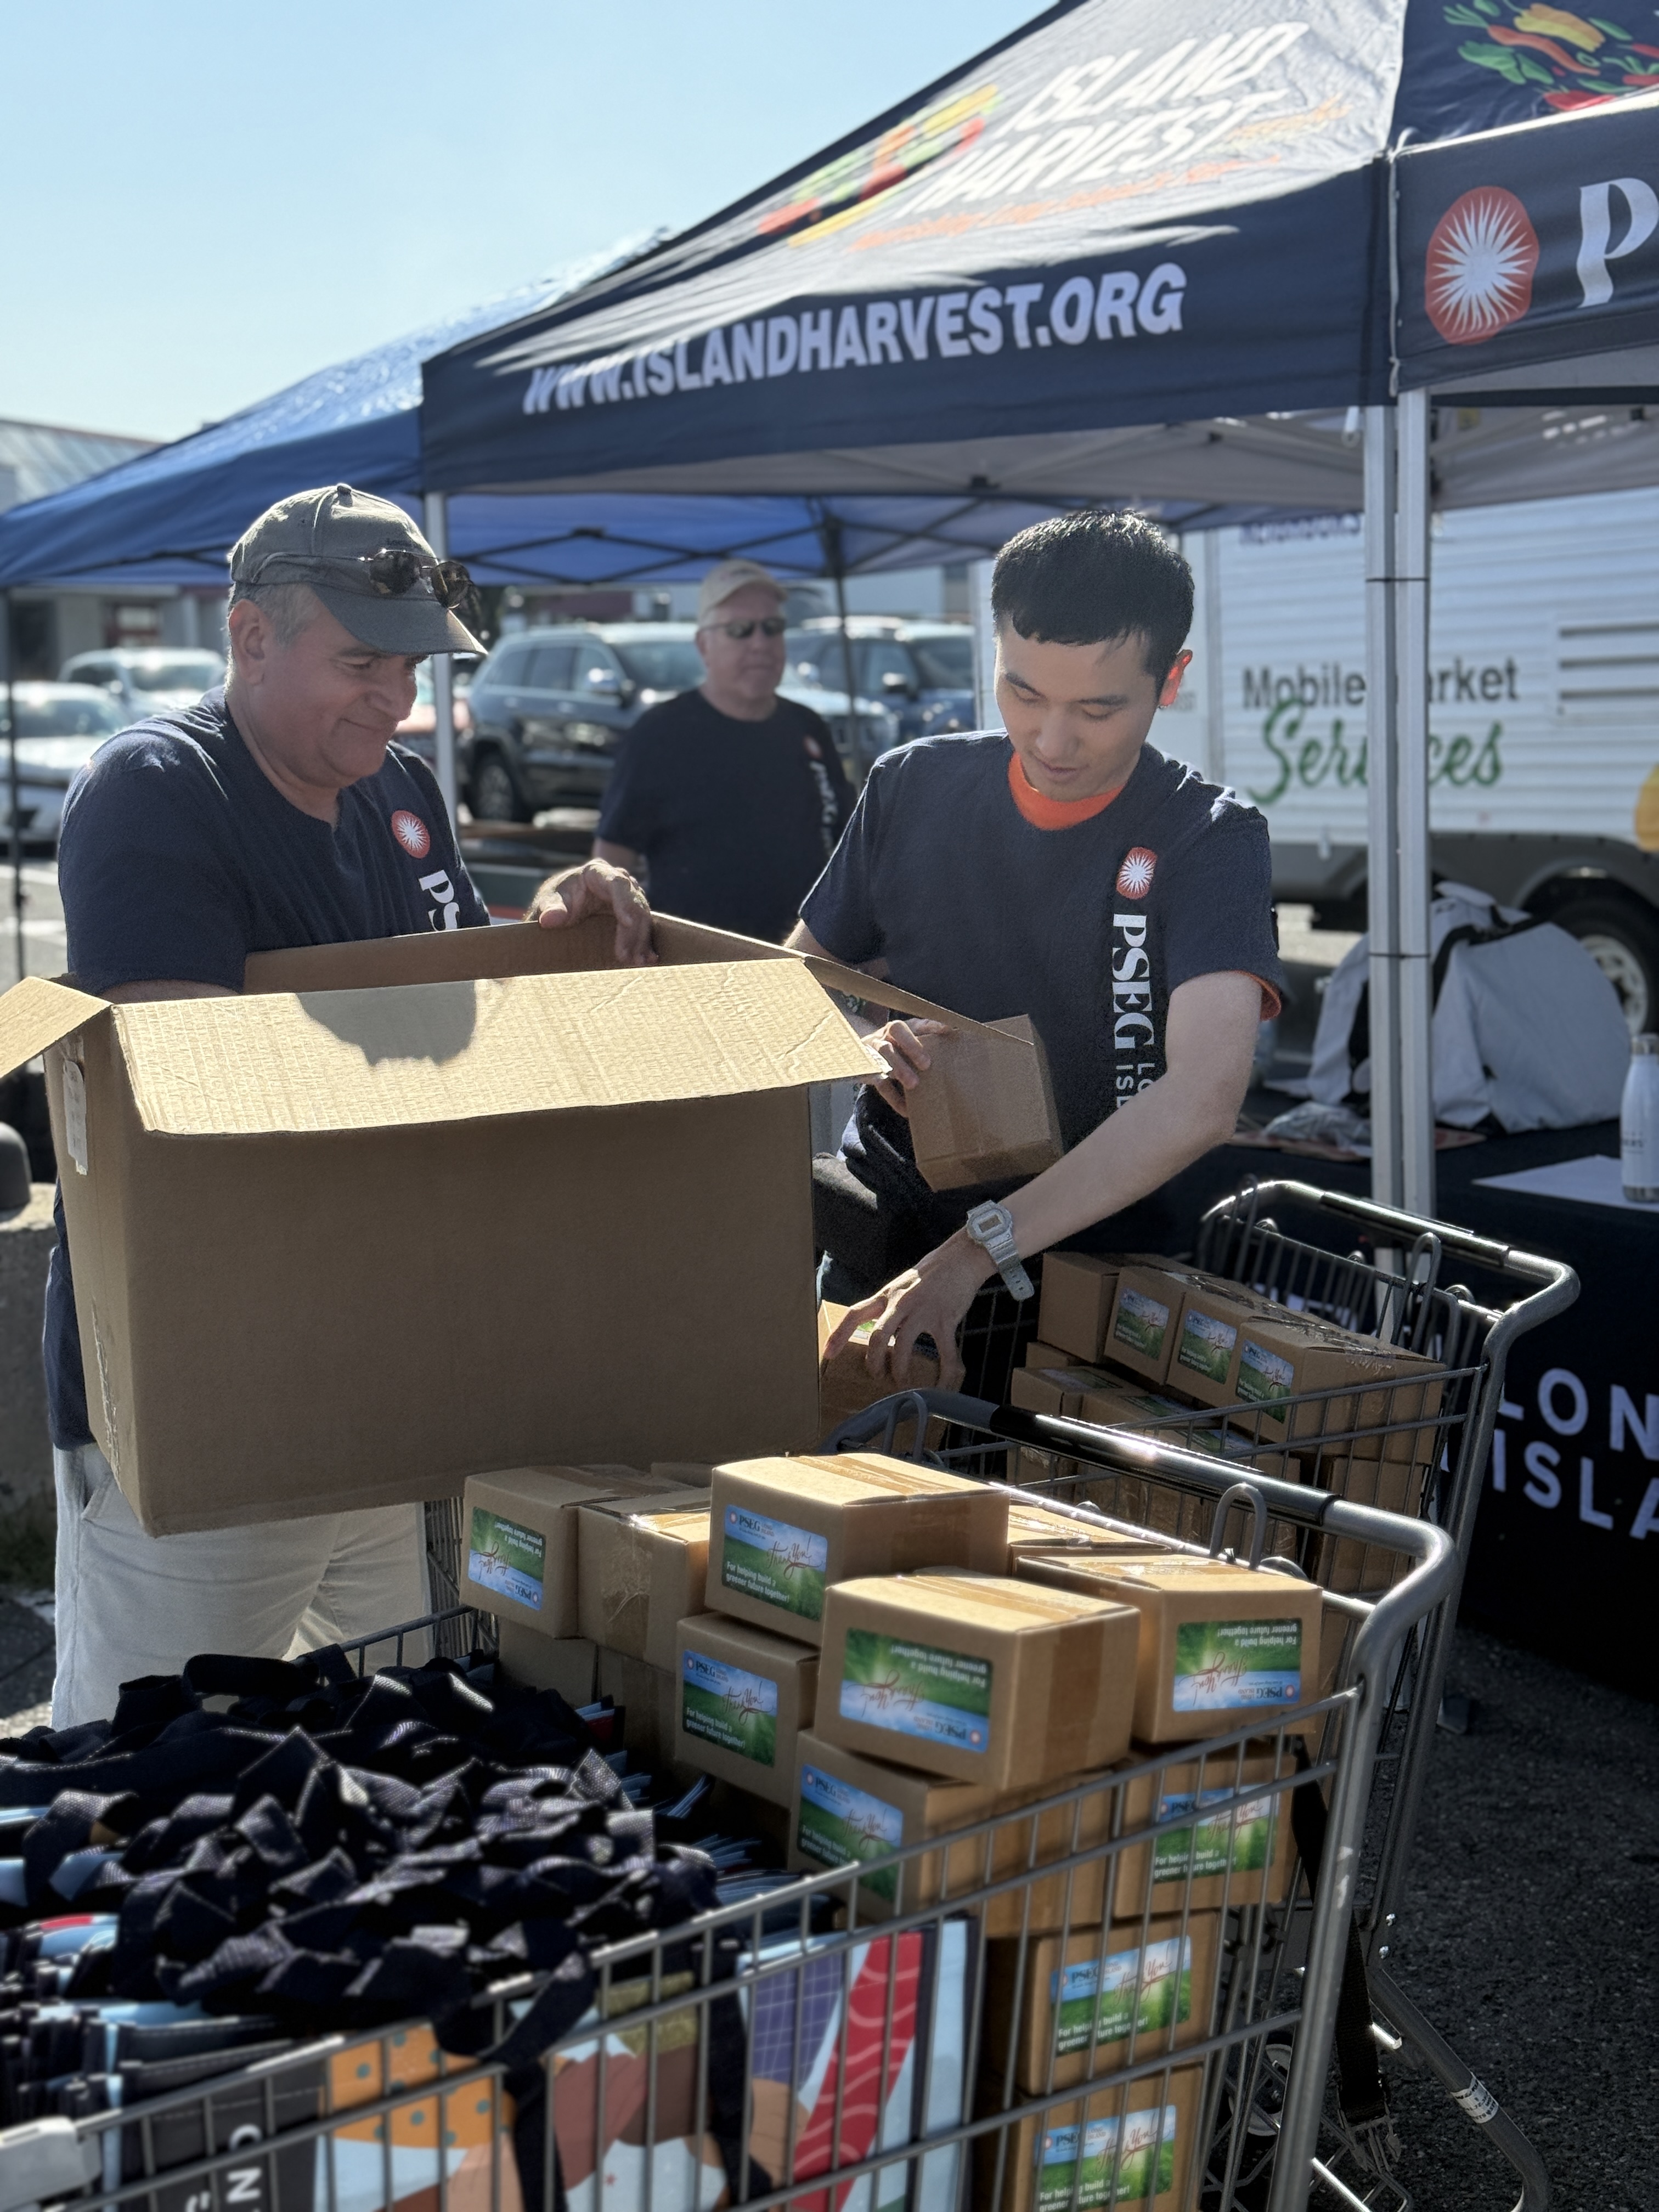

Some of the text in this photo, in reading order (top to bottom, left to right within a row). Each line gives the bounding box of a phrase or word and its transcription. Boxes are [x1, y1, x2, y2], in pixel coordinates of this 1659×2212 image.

[992, 21, 1310, 139] ISLAND
[1243, 663, 1366, 711] Mobile
[1112, 913, 1155, 1050] PSEG
[739, 1515, 760, 1531] PSEG
[726, 1561, 736, 1571] For
[1249, 1626, 1270, 1635] future
[1271, 1623, 1297, 1634] greener
[1240, 1637, 1258, 1648] build
[1260, 1635, 1284, 1646] helping
[1284, 1635, 1296, 1645] For
[696, 1660, 716, 1677] PSEG
[928, 1655, 953, 1668] future
[954, 1660, 988, 1674] greener
[917, 1662, 939, 1677] build
[940, 1667, 970, 1685] helping
[972, 1675, 986, 1689] For
[1255, 1686, 1283, 1700] PSEG
[1155, 1855, 1167, 1865] For
[1196, 1849, 1214, 1859] build
[1154, 1865, 1181, 1879] greener
[1058, 2028, 1072, 2038] For
[1103, 2012, 1122, 2025] build
[1058, 2034, 1089, 2051] greener
[1114, 2016, 1149, 2033] togeer!
[1040, 2191, 1052, 2202] For
[1085, 2179, 1104, 2192] build
